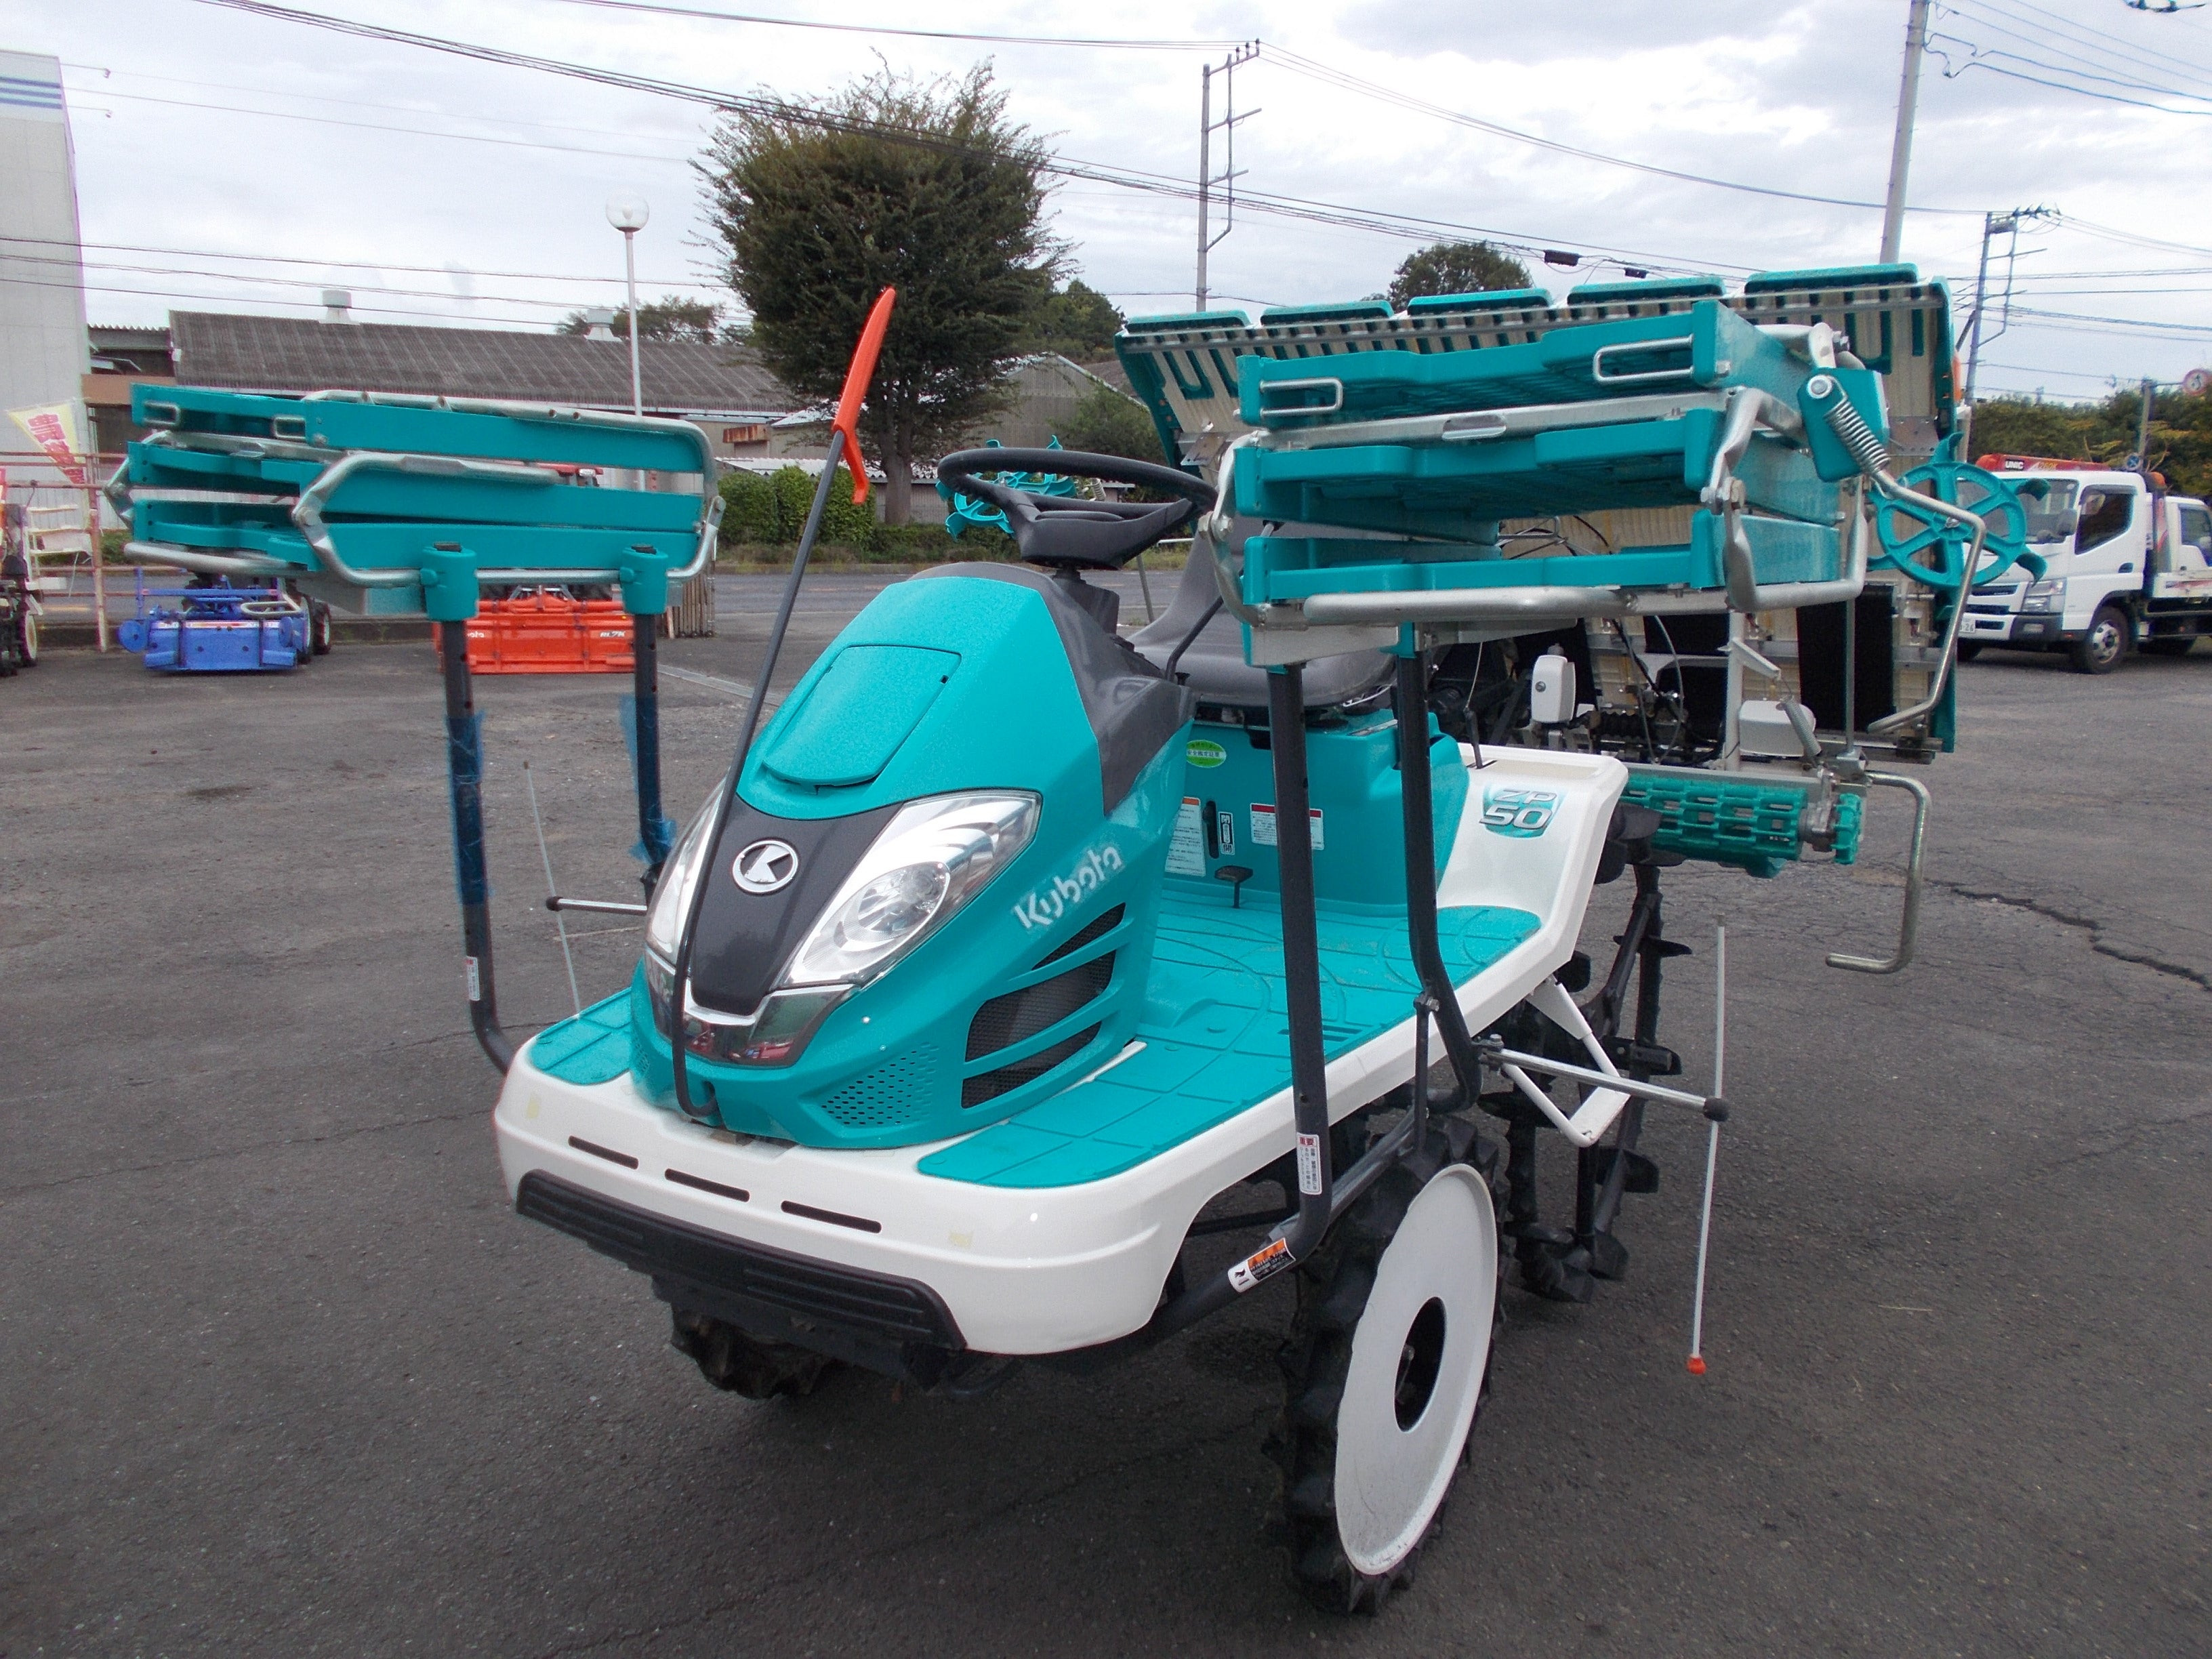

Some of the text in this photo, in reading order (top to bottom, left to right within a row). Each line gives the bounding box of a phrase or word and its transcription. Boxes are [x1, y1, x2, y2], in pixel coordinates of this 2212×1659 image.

[2005, 461, 2024, 470] UNIC
[1493, 789, 1557, 804] ZP
[1479, 804, 1553, 830] 50
[1014, 846, 1122, 929] Kubota
